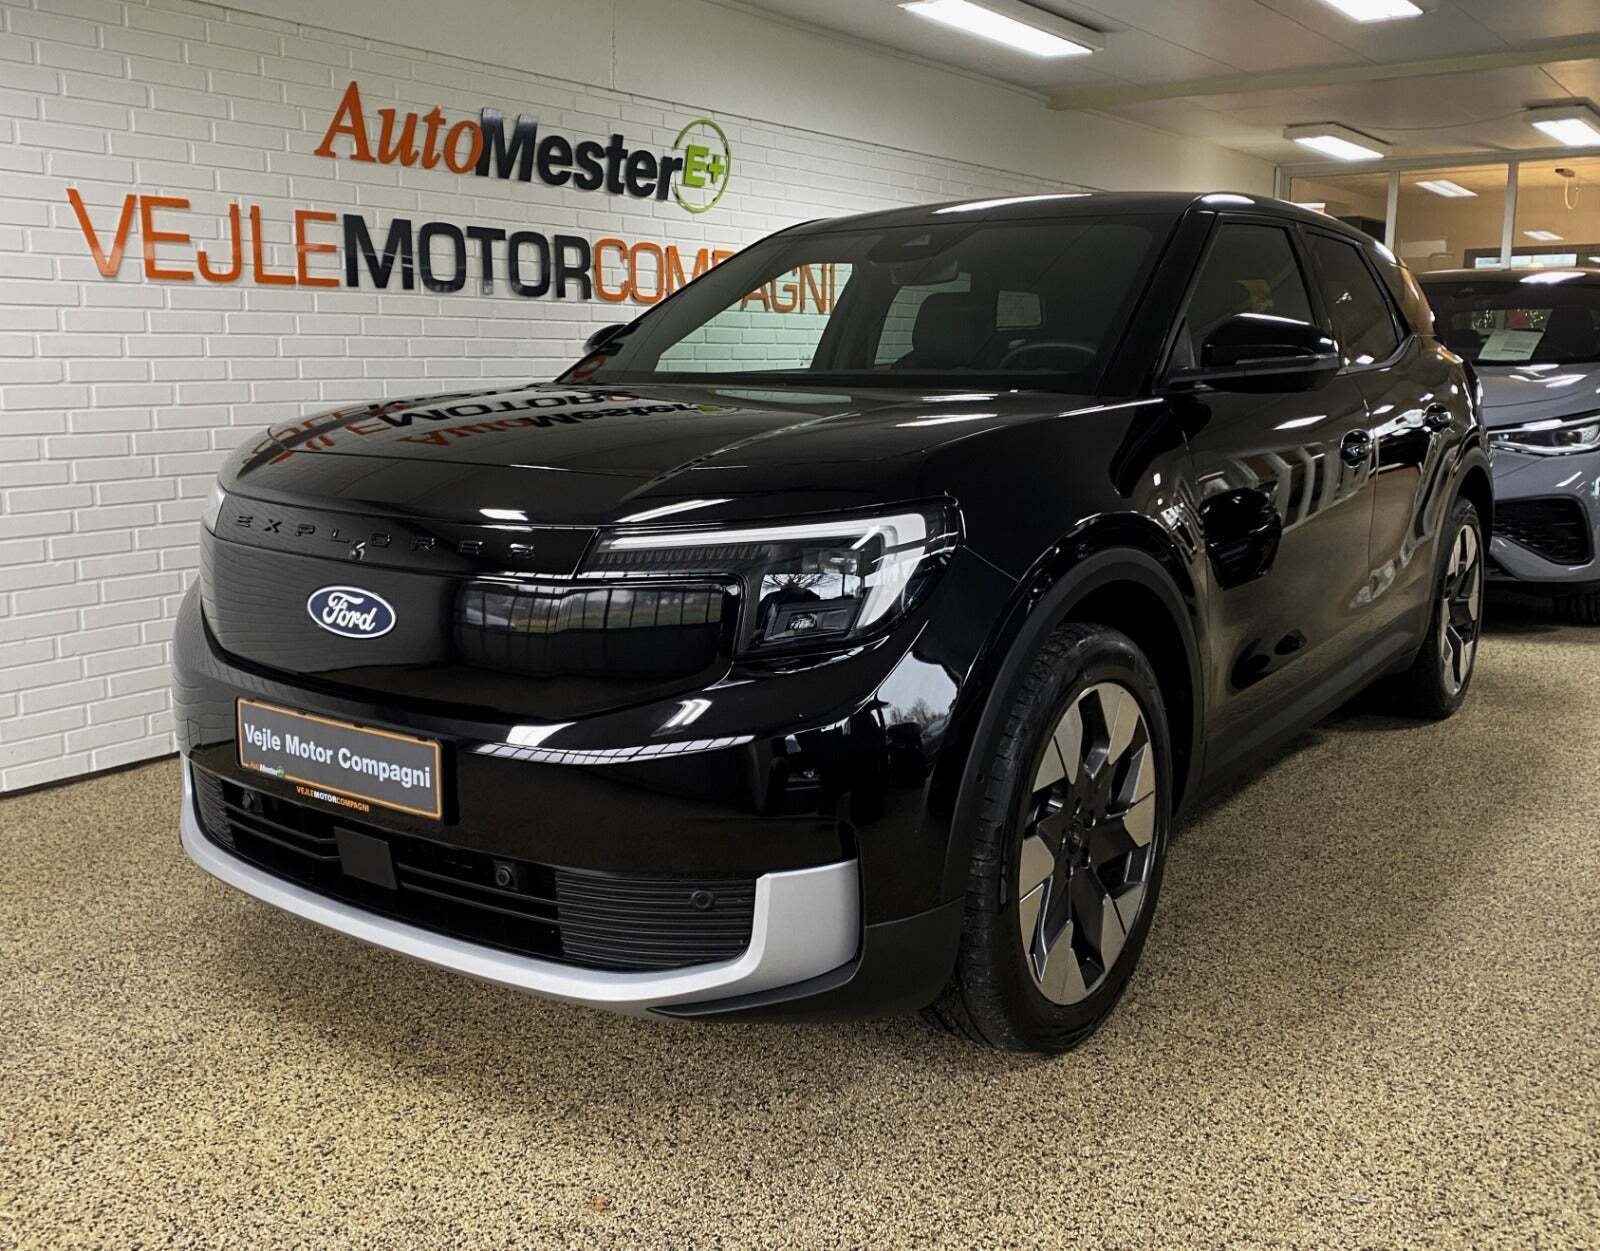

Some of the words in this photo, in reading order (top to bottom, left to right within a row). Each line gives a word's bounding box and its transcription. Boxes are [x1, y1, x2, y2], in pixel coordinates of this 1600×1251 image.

[313, 80, 683, 201] AutoMester
[236, 514, 535, 560] EXPLORER
[322, 592, 377, 631] Ford
[244, 722, 281, 751] Vejle
[285, 733, 334, 765] Motor
[338, 747, 431, 789] Compagni
